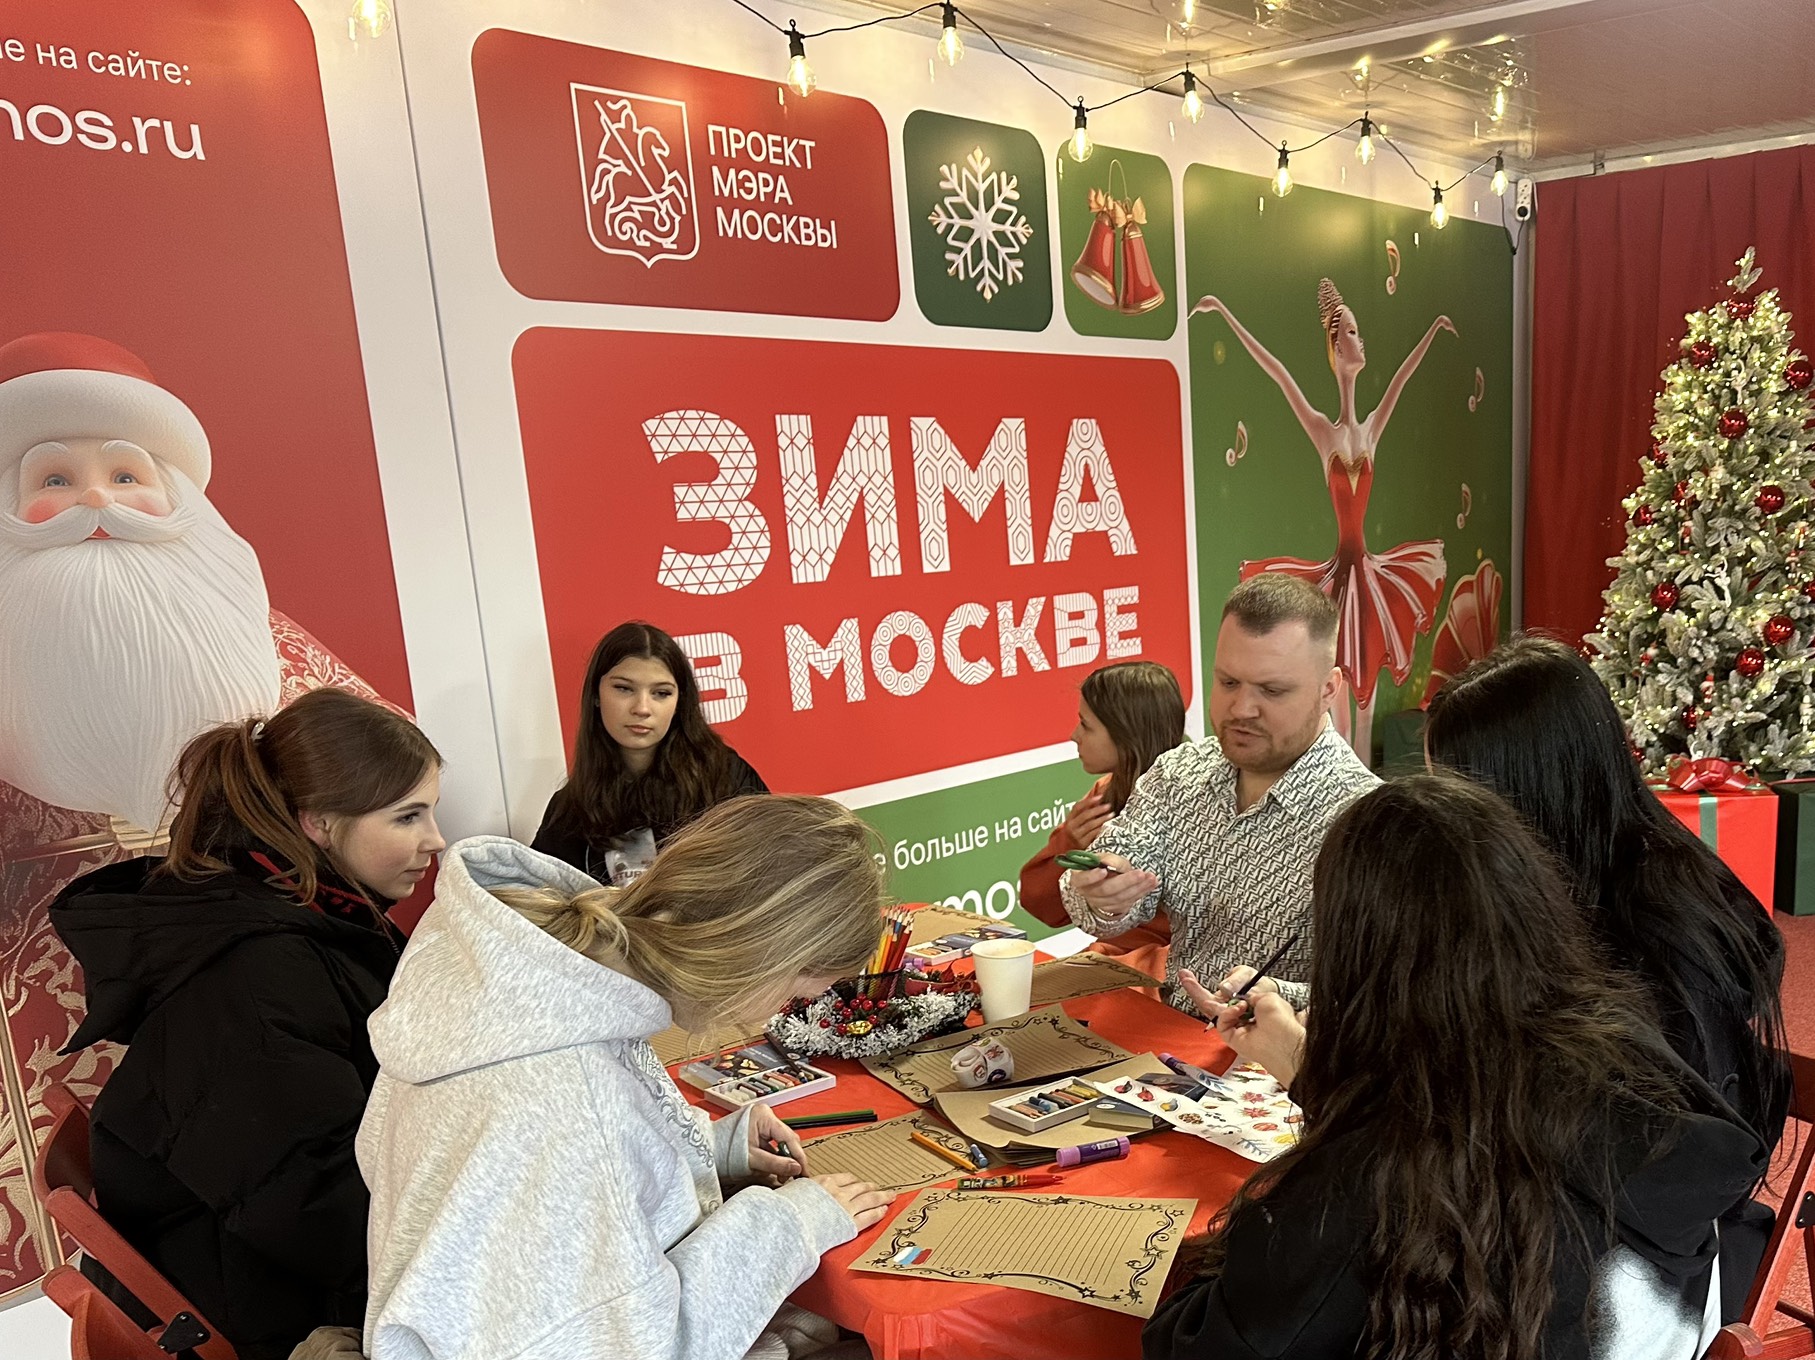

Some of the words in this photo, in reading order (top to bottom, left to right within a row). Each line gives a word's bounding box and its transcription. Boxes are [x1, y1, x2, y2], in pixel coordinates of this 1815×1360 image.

[36, 43, 78, 70] на
[87, 49, 192, 86] сайте:
[707, 124, 816, 170] ПРОЕКТ
[711, 165, 794, 206] МЭРА
[716, 206, 838, 250] МОСКВЫ
[641, 408, 1139, 596] ЗИМА
[672, 631, 748, 726] В
[783, 585, 1143, 712] МОСКВЕ
[893, 825, 989, 870] больше
[995, 816, 1022, 842] на
